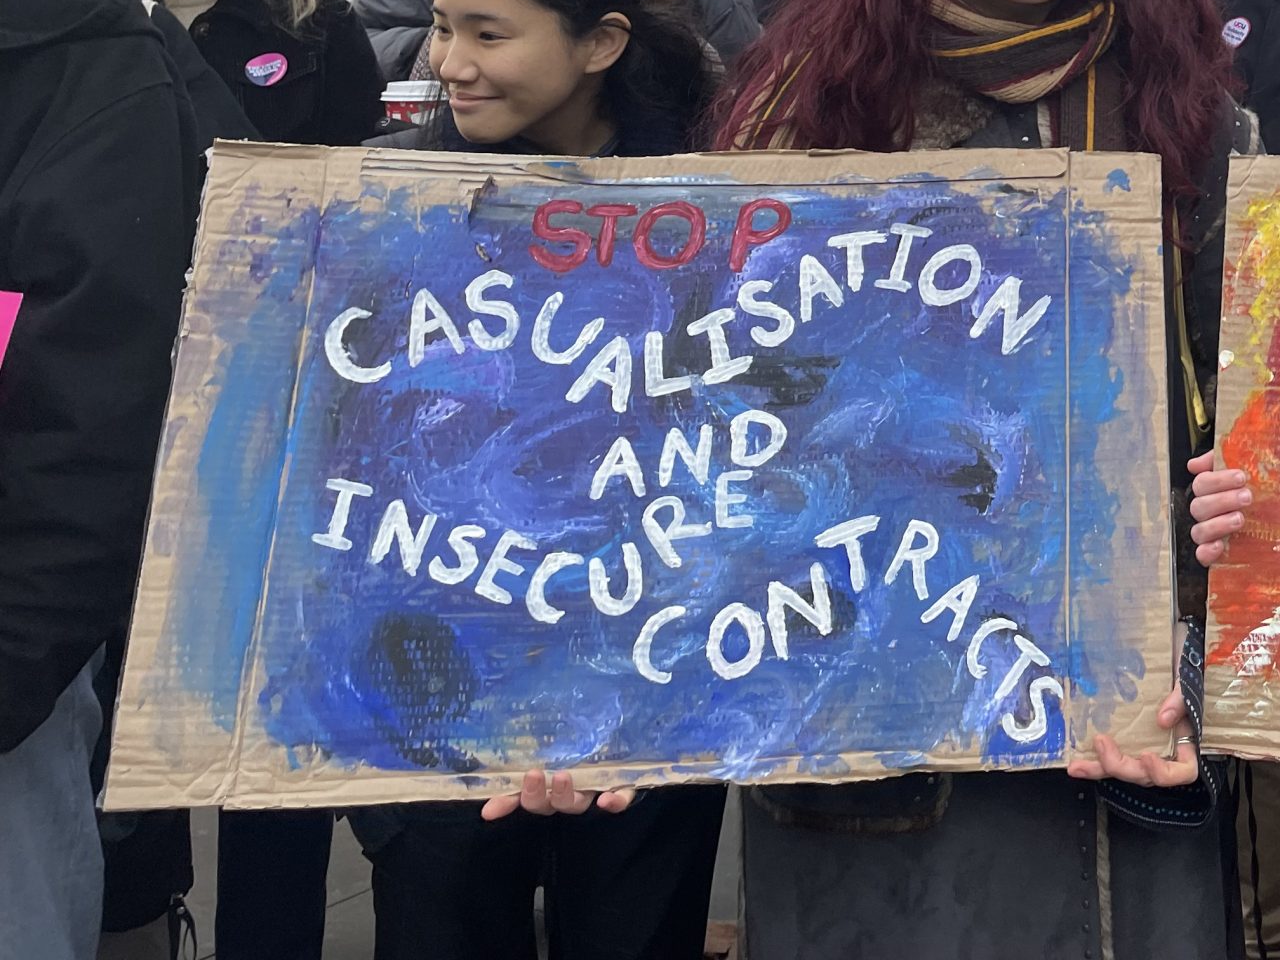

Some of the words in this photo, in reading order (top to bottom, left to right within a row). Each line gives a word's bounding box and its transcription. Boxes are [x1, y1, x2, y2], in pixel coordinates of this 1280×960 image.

[529, 198, 792, 272] STOP
[325, 222, 1052, 413] CASUALISATION
[590, 409, 788, 500] AND
[311, 470, 754, 624] INSECURE
[633, 515, 1064, 743] CONTRACTS
